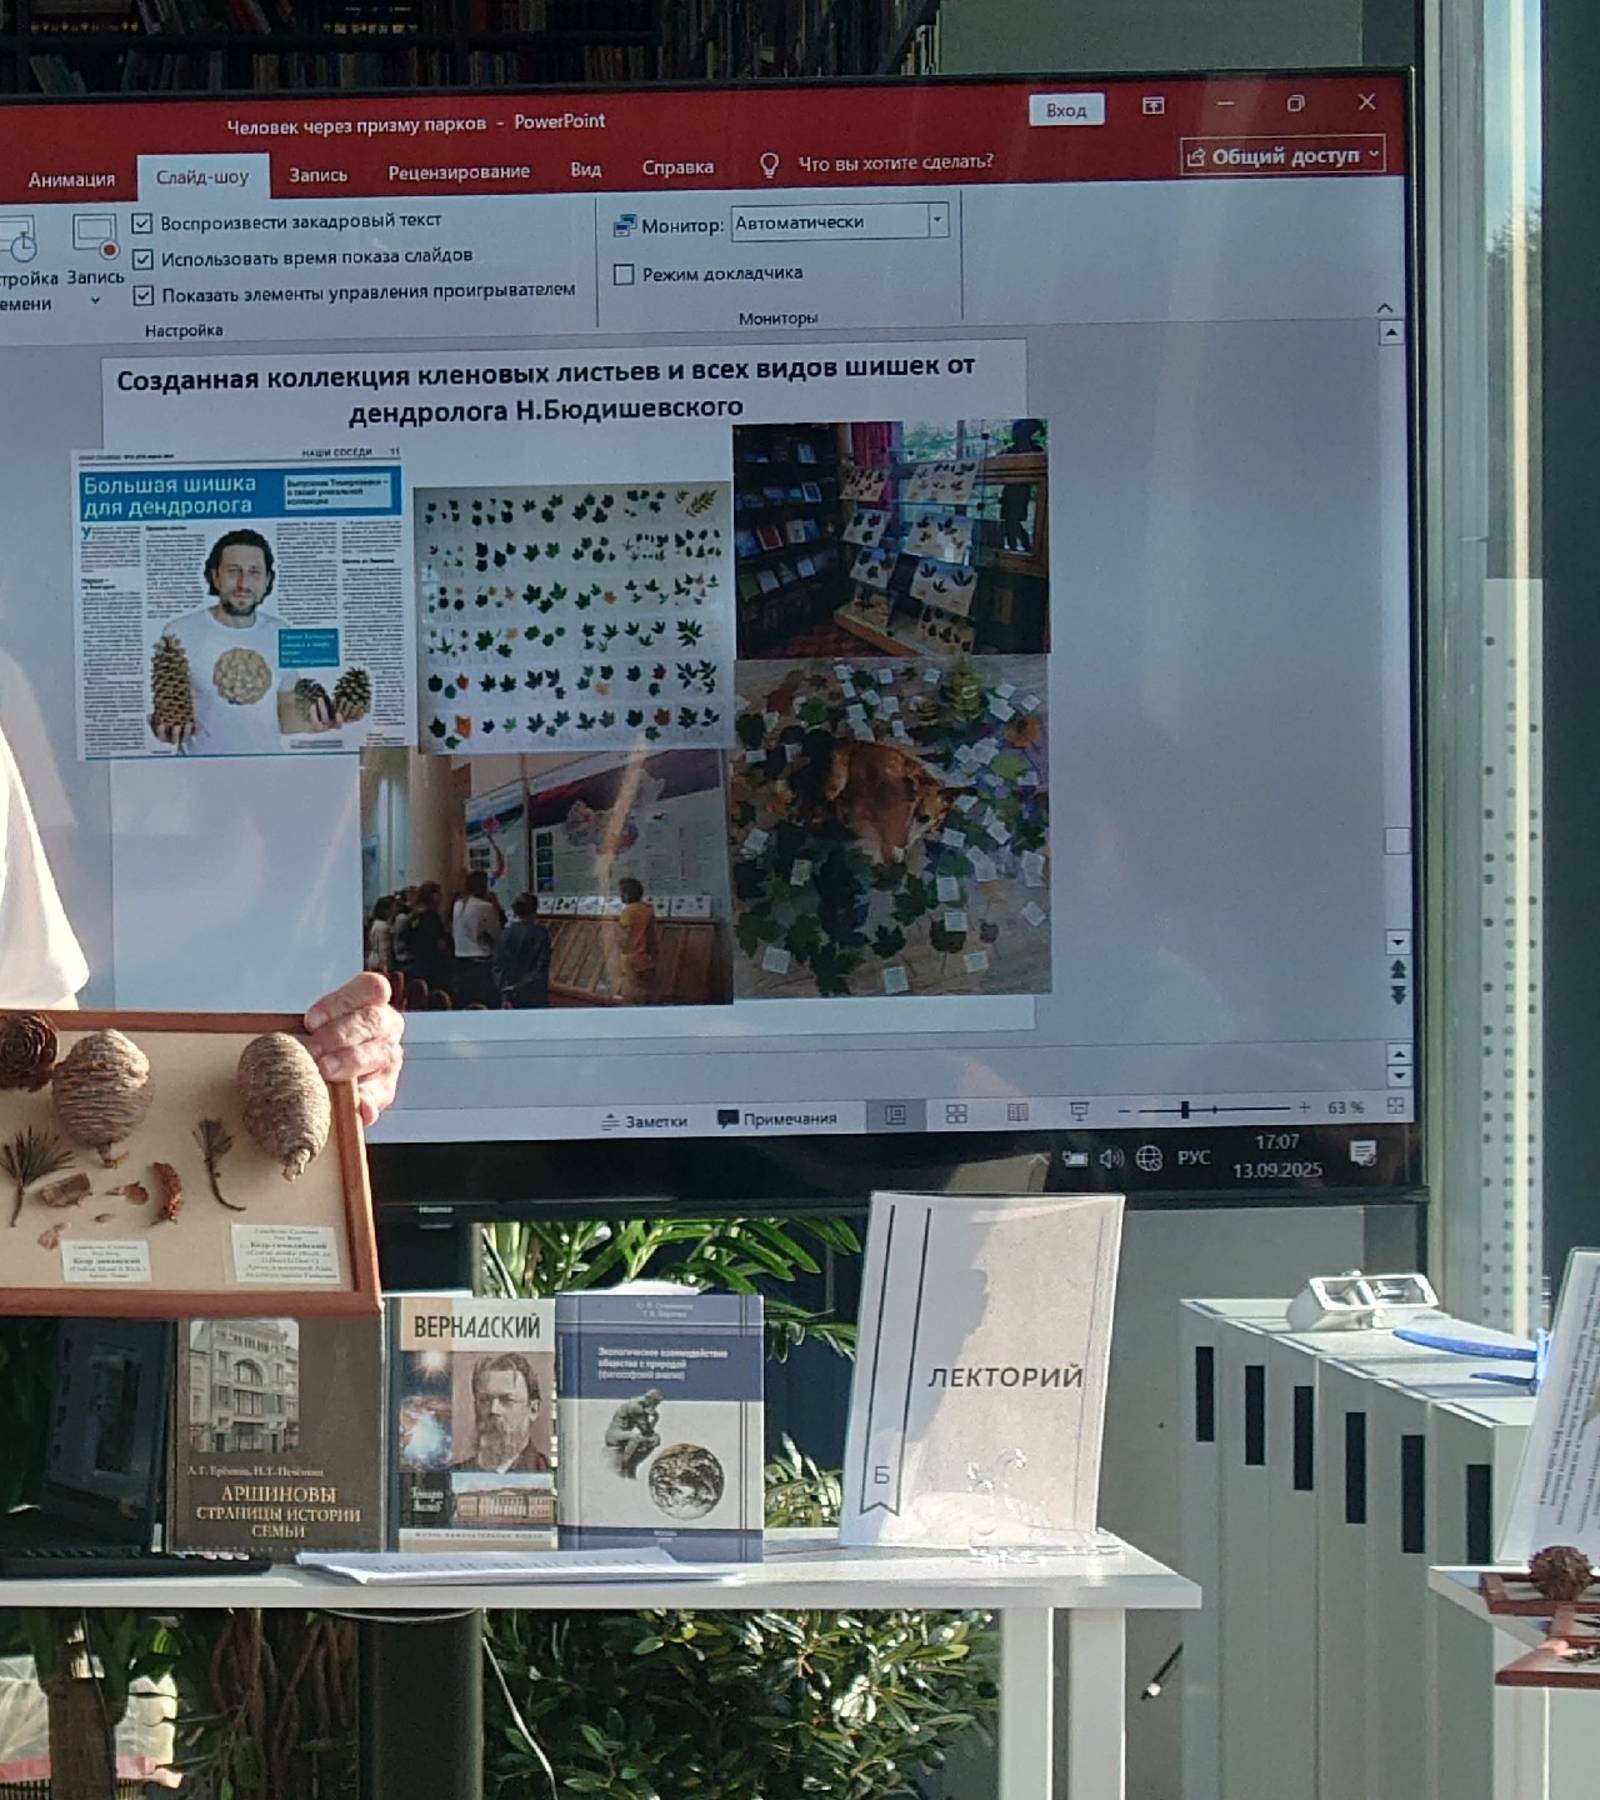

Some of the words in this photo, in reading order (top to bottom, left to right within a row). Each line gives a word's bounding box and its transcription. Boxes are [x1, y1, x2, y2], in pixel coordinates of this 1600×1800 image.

[1046, 101, 1088, 121] Вход
[227, 120, 299, 136] Человек
[303, 121, 353, 137] через
[357, 120, 420, 136] призму
[424, 118, 487, 135] парков
[514, 112, 606, 131] PowerPoint
[799, 154, 830, 174] Что
[836, 159, 859, 174] вы
[863, 157, 918, 173] хотите
[922, 152, 995, 175] сделать?
[1212, 145, 1286, 169] Общий
[1290, 146, 1361, 169] доступ
[155, 168, 250, 188] Слайд-шоу
[288, 167, 349, 184] Запись
[388, 163, 531, 182] Рецензирование
[570, 160, 602, 179] Вид
[642, 157, 716, 179] Справка
[28, 171, 116, 188] Анимация
[160, 214, 287, 233] Воспроизвести
[292, 211, 396, 231] закадровый
[400, 213, 442, 228] текст
[641, 215, 726, 238] Монитор:
[735, 212, 865, 234] Автоматически
[160, 251, 279, 269] Использовать
[283, 251, 338, 268] время
[341, 249, 400, 265] показа
[404, 247, 473, 265] слайдов
[67, 269, 126, 287] Запись
[642, 265, 699, 284] Режим
[704, 264, 804, 285] докладчика
[161, 287, 239, 304] Показать
[244, 286, 325, 303] элементы
[329, 285, 429, 304] управления
[432, 281, 577, 301] проигрывателем
[738, 310, 819, 328] Мониторы
[144, 323, 224, 341] Настройка
[117, 370, 259, 396] Созданная
[267, 368, 410, 392] коллекция
[417, 365, 549, 388] кленовых
[555, 358, 661, 385] листьев
[667, 361, 685, 382] и
[691, 359, 749, 382] всех
[756, 355, 838, 382] видов
[844, 355, 942, 378] шишек
[947, 357, 977, 377] от
[348, 401, 508, 429] дендролога
[516, 395, 745, 425] Н.Бюдишевского
[301, 448, 332, 457] НАШИ
[333, 447, 373, 457] СОСЕДИ
[84, 477, 178, 495] Большая
[183, 476, 257, 494] шишка
[84, 500, 123, 519] для
[128, 499, 252, 518] дендролога
[1327, 1101, 1348, 1115] 63
[1350, 1101, 1365, 1114] %
[625, 1113, 688, 1129] Заметки
[743, 1110, 838, 1128] Примечания
[1255, 1132, 1301, 1152] 17:07
[1177, 1149, 1213, 1167] РУС
[1232, 1160, 1324, 1180] 13.09.2025
[413, 1312, 542, 1340] ВЕРНАДСКИЙ
[927, 1363, 1085, 1389] ЛЕКТОРИЙ
[874, 1465, 891, 1485] Б
[221, 1485, 337, 1504] АРШИНОВЫ
[196, 1506, 282, 1522] СТРАНИЦЫ
[286, 1508, 361, 1523] ИСТОРИИ
[252, 1524, 305, 1539] СЕМЬИ
